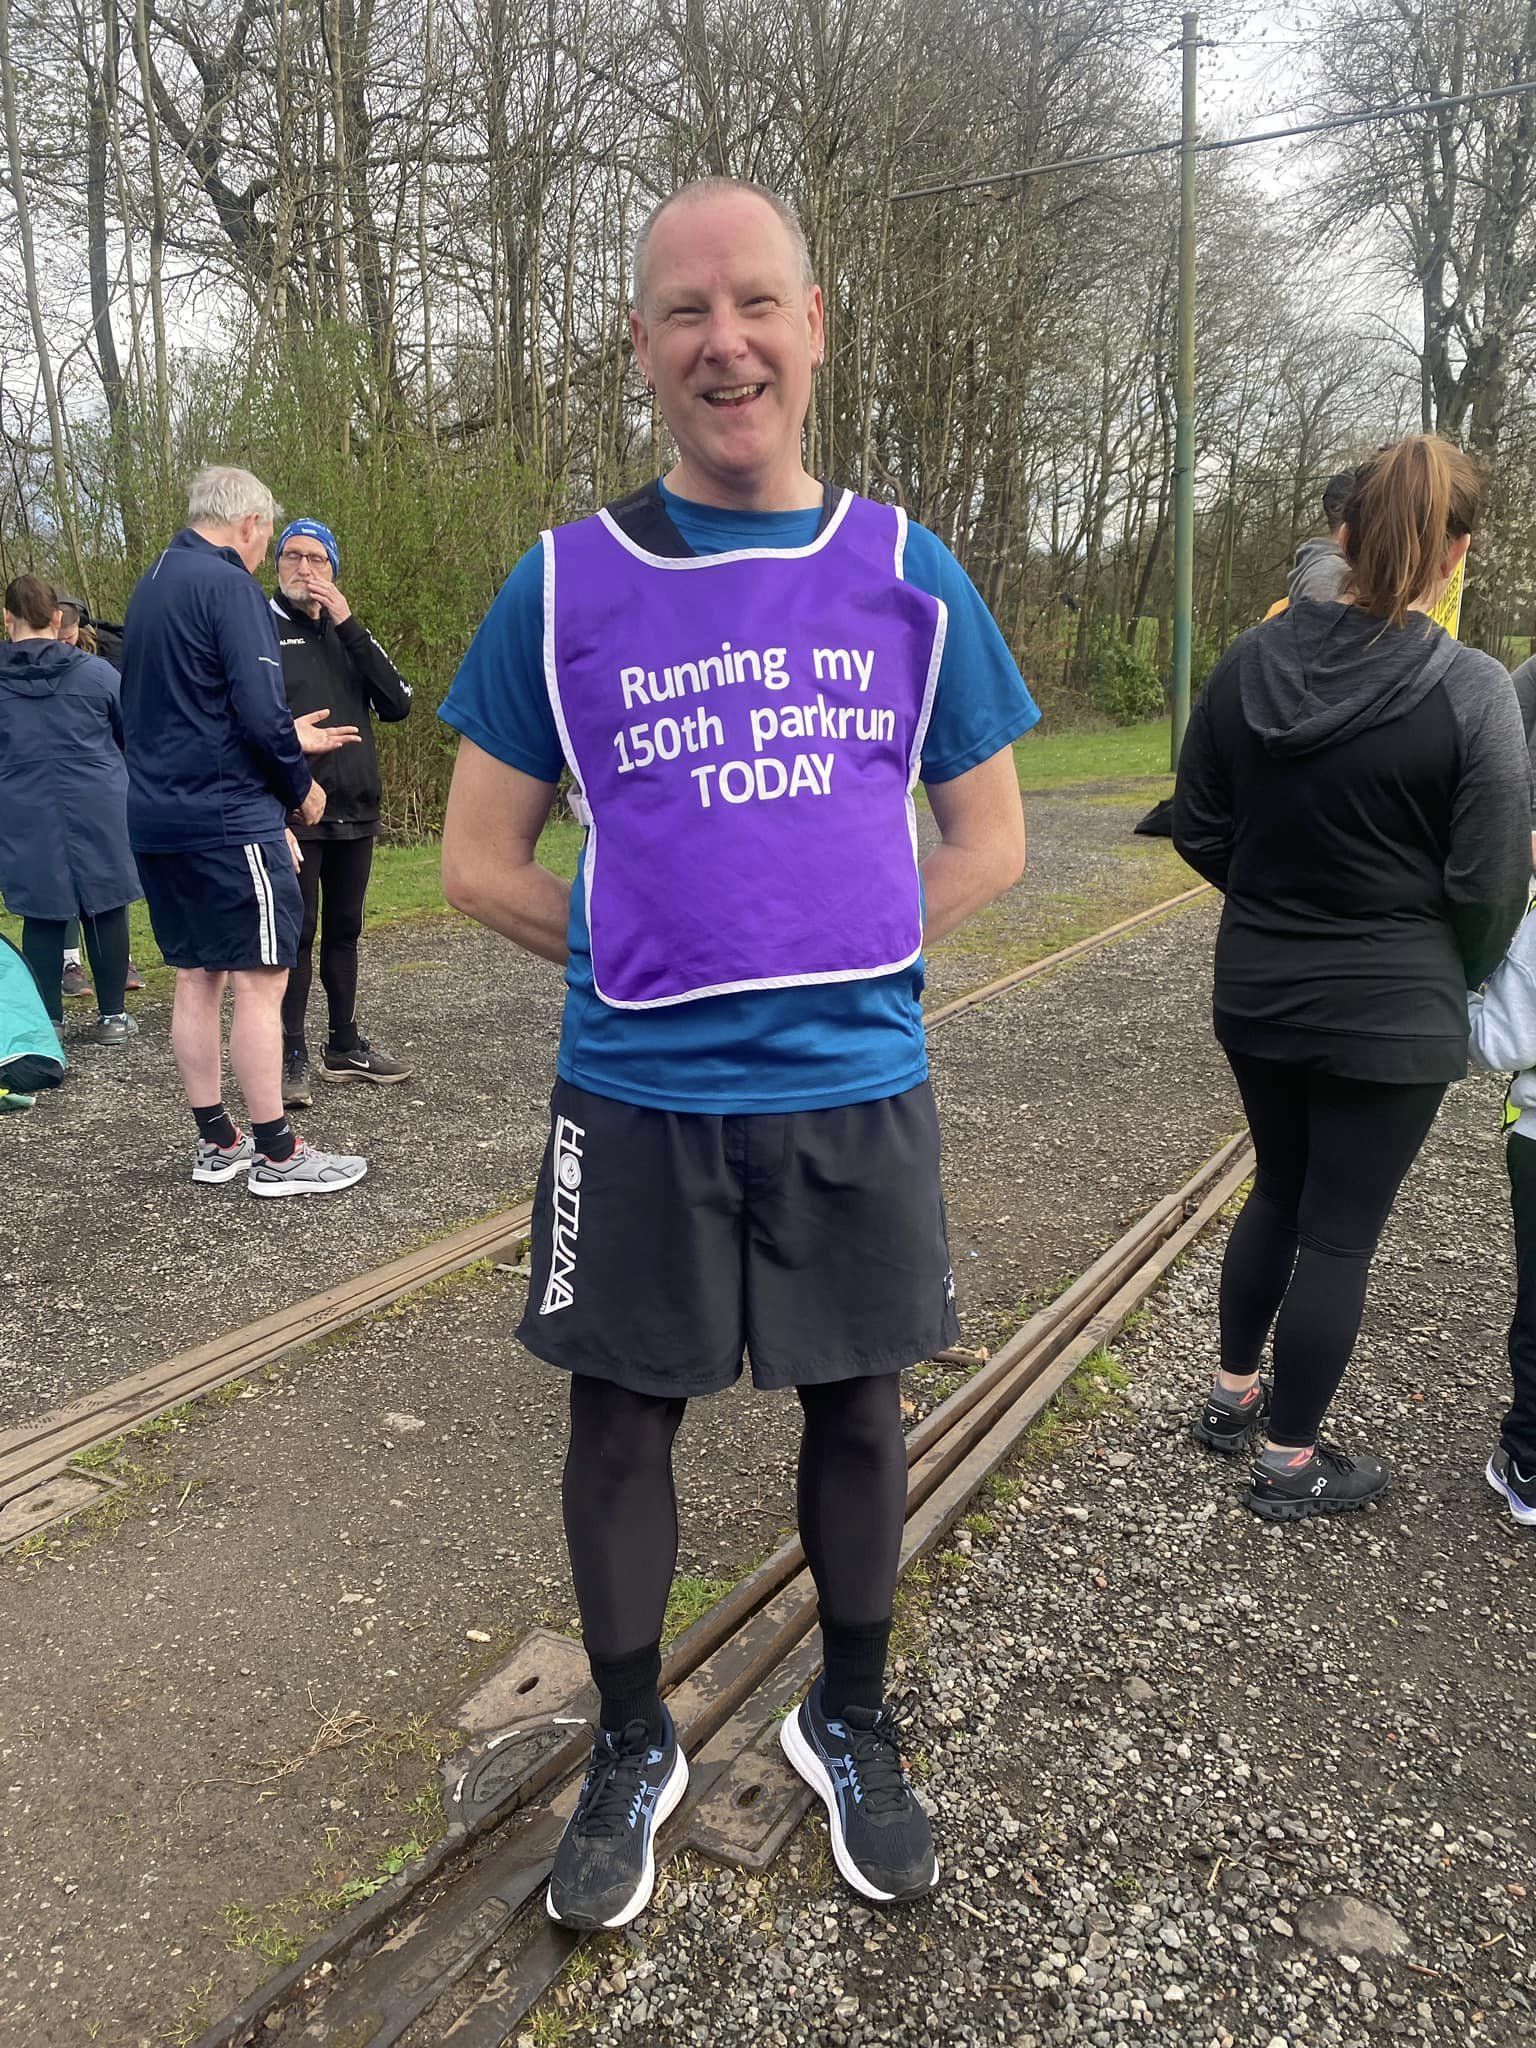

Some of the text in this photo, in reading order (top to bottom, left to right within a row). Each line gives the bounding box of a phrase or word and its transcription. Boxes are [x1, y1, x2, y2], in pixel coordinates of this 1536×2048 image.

[620, 641, 875, 709] Running my
[613, 693, 895, 773] 150th parkrun
[690, 752, 835, 808] TODAY
